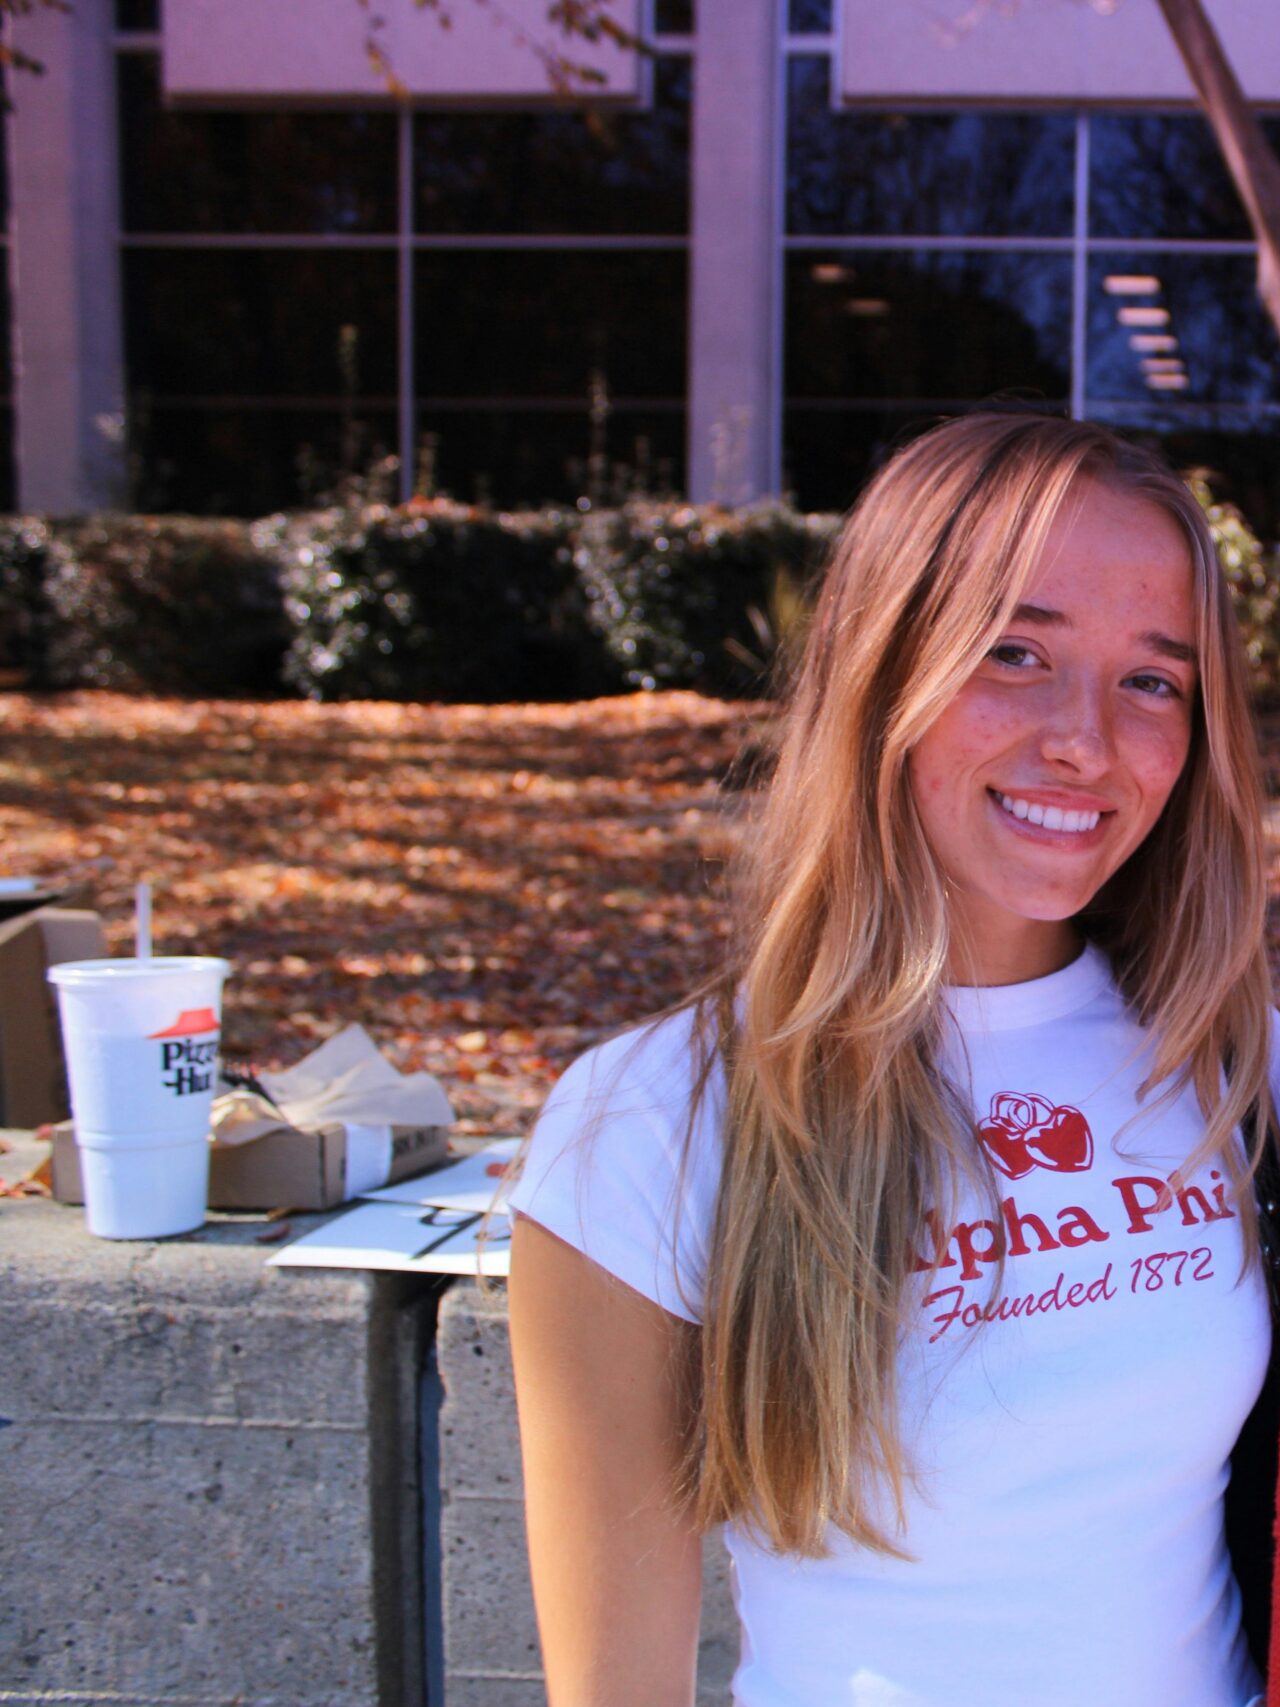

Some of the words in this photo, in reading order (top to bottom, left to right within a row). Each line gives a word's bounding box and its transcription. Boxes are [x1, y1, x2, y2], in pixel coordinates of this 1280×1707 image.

[904, 1196, 1109, 1281] lpha
[1111, 1169, 1236, 1234] Phi
[921, 1272, 1117, 1344] Founded
[1129, 1246, 1216, 1294] 1872
